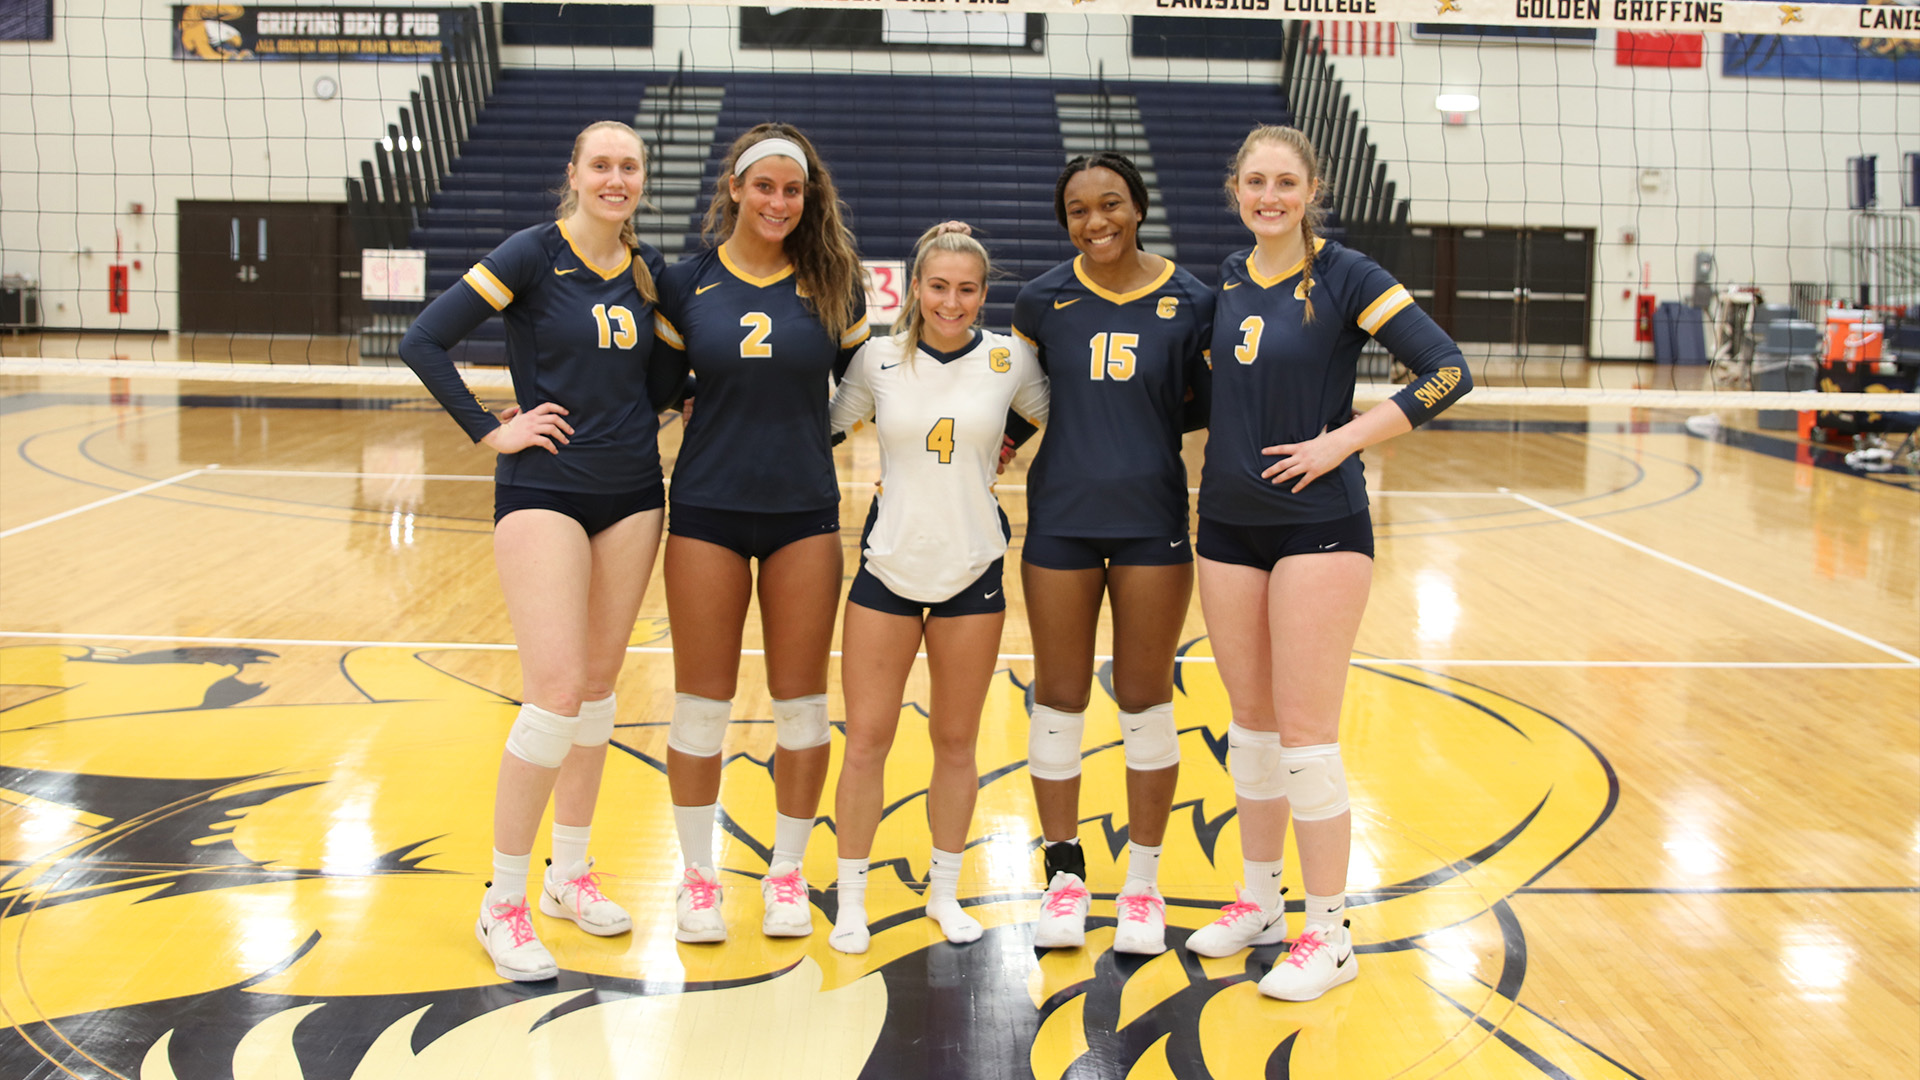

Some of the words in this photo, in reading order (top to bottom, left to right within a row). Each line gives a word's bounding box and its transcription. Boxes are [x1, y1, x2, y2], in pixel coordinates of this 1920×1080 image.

[257, 12, 340, 35] GRIFFINS
[343, 12, 381, 36] DEN
[384, 13, 399, 36] &
[402, 13, 440, 36] PUB
[1516, 0, 1600, 19] GOLDEN
[1614, 1, 1723, 23] GRIFFINS
[255, 39, 276, 53] ALL
[873, 266, 899, 310] 3
[592, 304, 637, 349] 13
[740, 312, 772, 358] 2
[1234, 315, 1265, 365] 3
[1089, 332, 1139, 381] 15
[926, 417, 955, 464] 4
